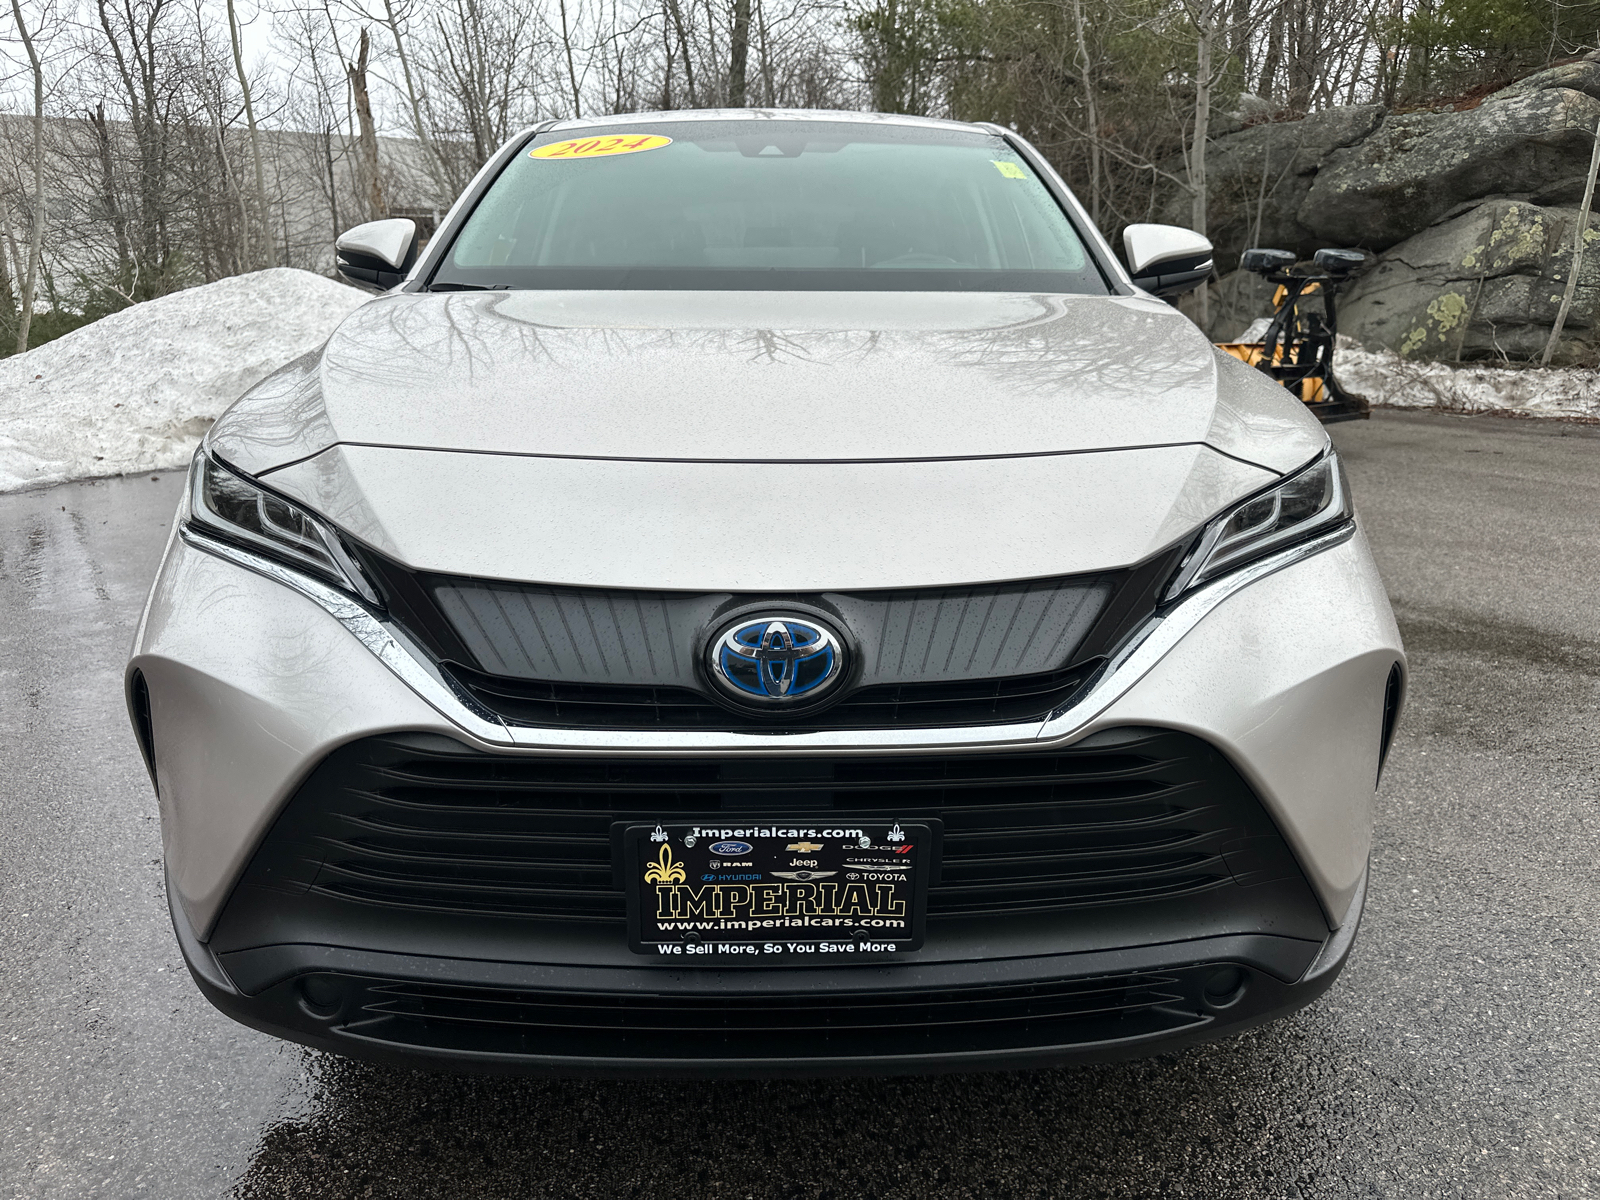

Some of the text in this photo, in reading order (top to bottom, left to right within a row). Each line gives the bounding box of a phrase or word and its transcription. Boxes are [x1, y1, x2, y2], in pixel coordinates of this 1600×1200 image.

[547, 136, 652, 157] 2024
[693, 826, 863, 839] Imperialcars.com
[719, 844, 742, 853] Ford
[789, 858, 818, 868] Jeep
[862, 873, 907, 881] TOYOTA
[656, 883, 906, 919] IMPERIAL
[657, 916, 905, 931] www.imperialcars.com
[658, 942, 896, 955] We Sell More, So You Save More
